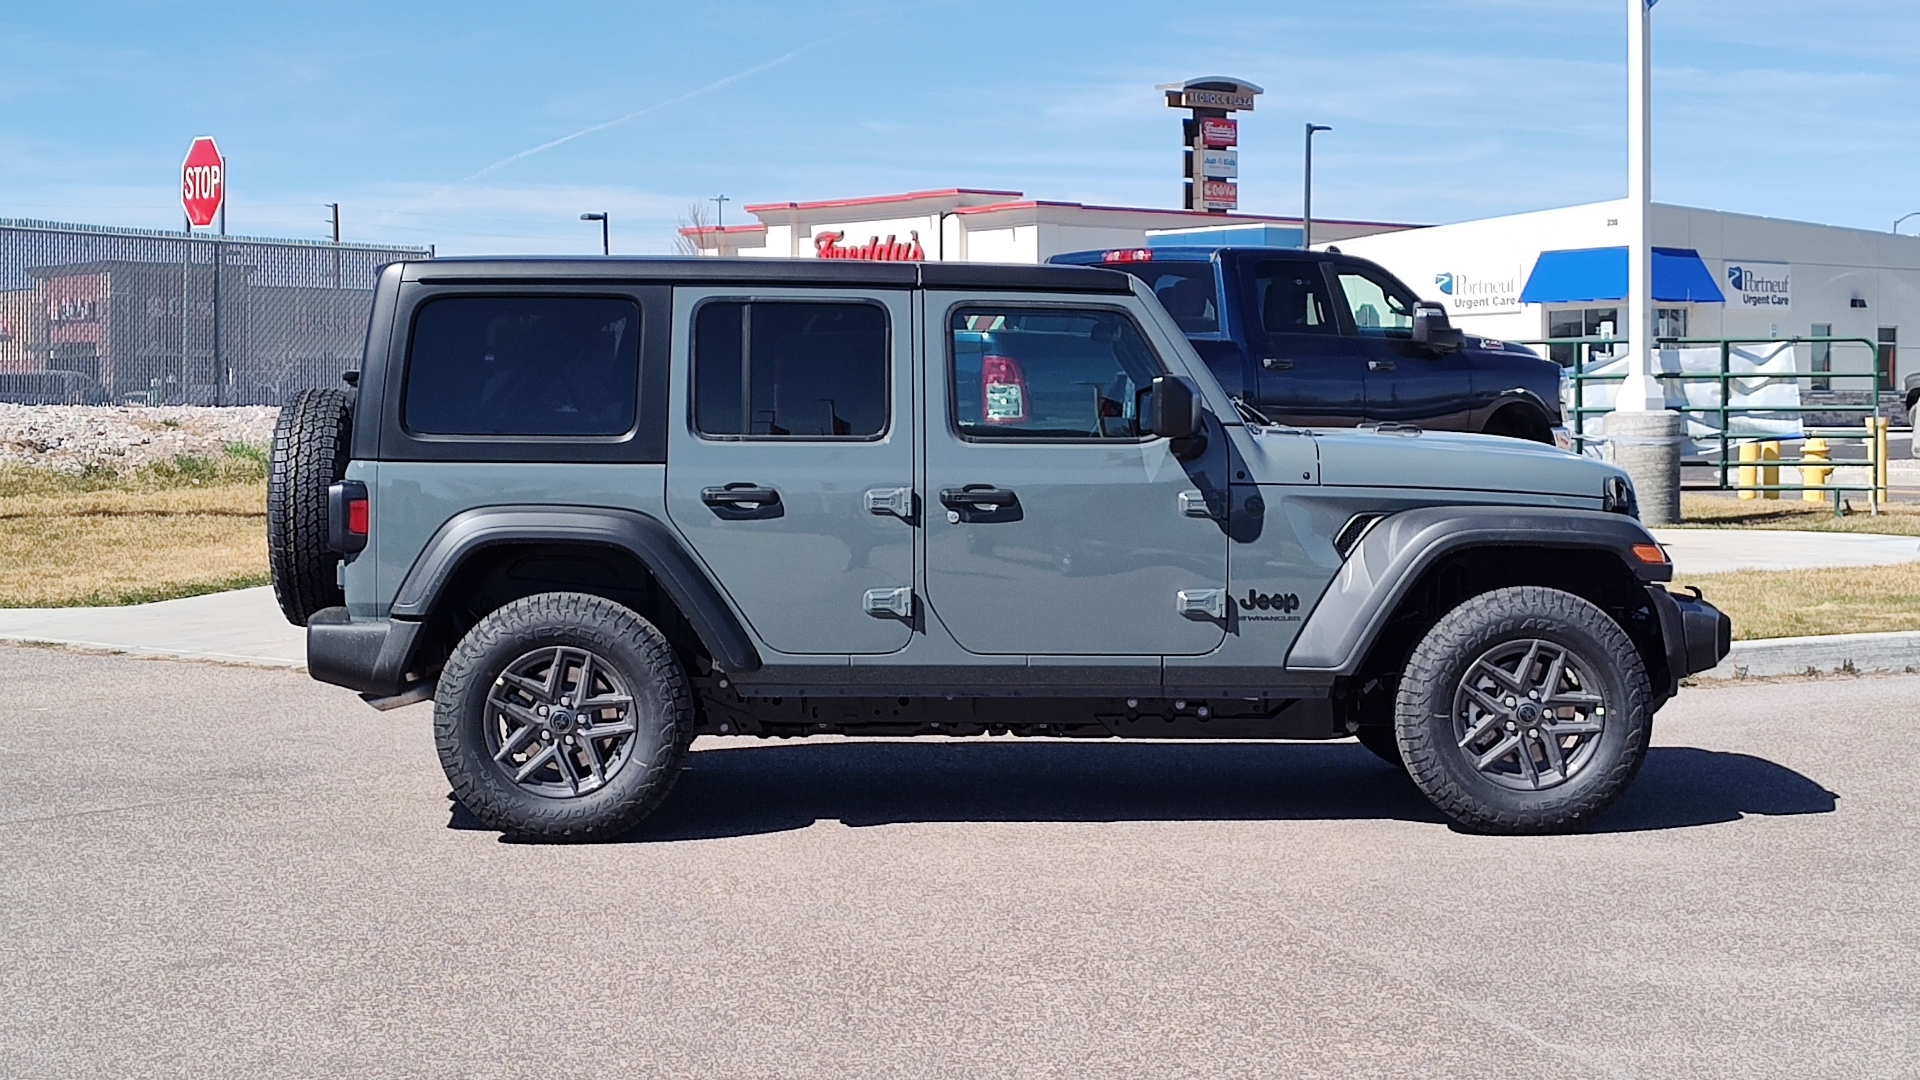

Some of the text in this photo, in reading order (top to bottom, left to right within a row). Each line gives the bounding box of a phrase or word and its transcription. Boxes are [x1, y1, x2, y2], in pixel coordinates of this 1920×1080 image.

[1229, 95, 1252, 106] PLAZA
[184, 165, 220, 200] STOP
[1455, 274, 1515, 295] Portneuf
[1744, 270, 1789, 292] Portneuf
[1454, 296, 1516, 309] Urgent Care
[1743, 294, 1789, 306] Urgent Care
[1239, 589, 1300, 614] Jeep
[514, 625, 615, 650] NEXEN
